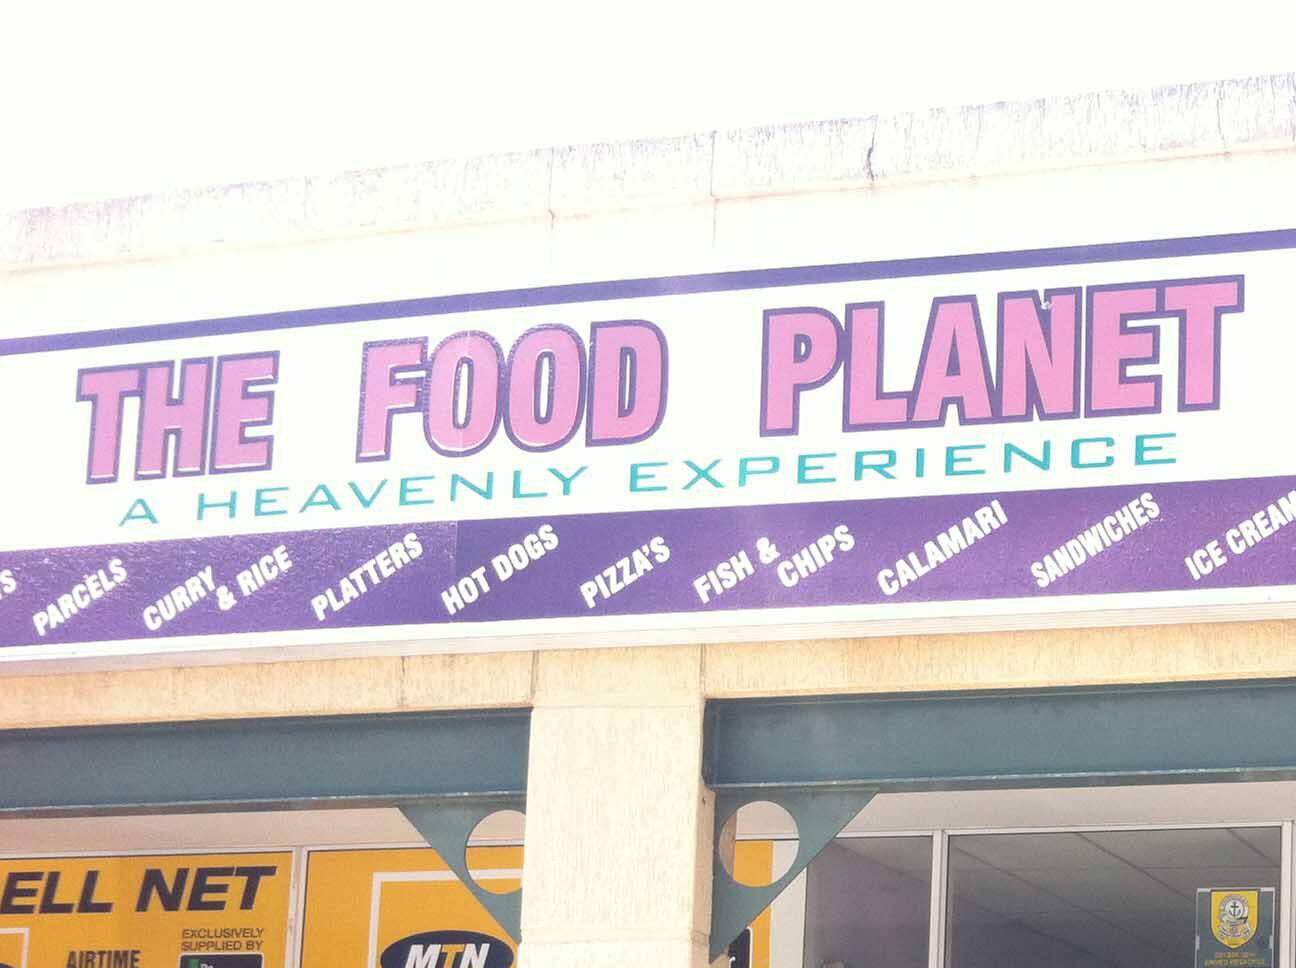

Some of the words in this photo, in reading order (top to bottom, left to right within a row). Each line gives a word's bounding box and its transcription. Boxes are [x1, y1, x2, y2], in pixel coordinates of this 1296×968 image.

[75, 350, 280, 485] THE
[355, 319, 669, 462] FOOD
[760, 274, 1244, 437] PLANET
[119, 498, 159, 527] A
[196, 465, 589, 522] HEAVENLY
[629, 433, 1177, 493] EXPERIENCE
[440, 568, 490, 615] HOT
[490, 524, 561, 583] DOGS
[579, 535, 671, 609] PIZZA'S
[693, 548, 754, 604] FISH
[756, 535, 781, 565] &
[776, 523, 856, 590] CHIPS
[876, 499, 1009, 596] CALAMARI
[1030, 491, 1161, 589] SANDWICHES
[1184, 534, 1227, 581] ICE
[32, 557, 128, 636] PARCELS
[142, 565, 219, 632] CURRY
[215, 583, 236, 611] &
[237, 545, 294, 598] RICE
[310, 531, 425, 622] PLATTERS
[135, 865, 277, 912] NET
[181, 940, 242, 951] SUPPLIED
[245, 940, 263, 950] BY
[182, 928, 264, 939] EXCLUSIVELY
